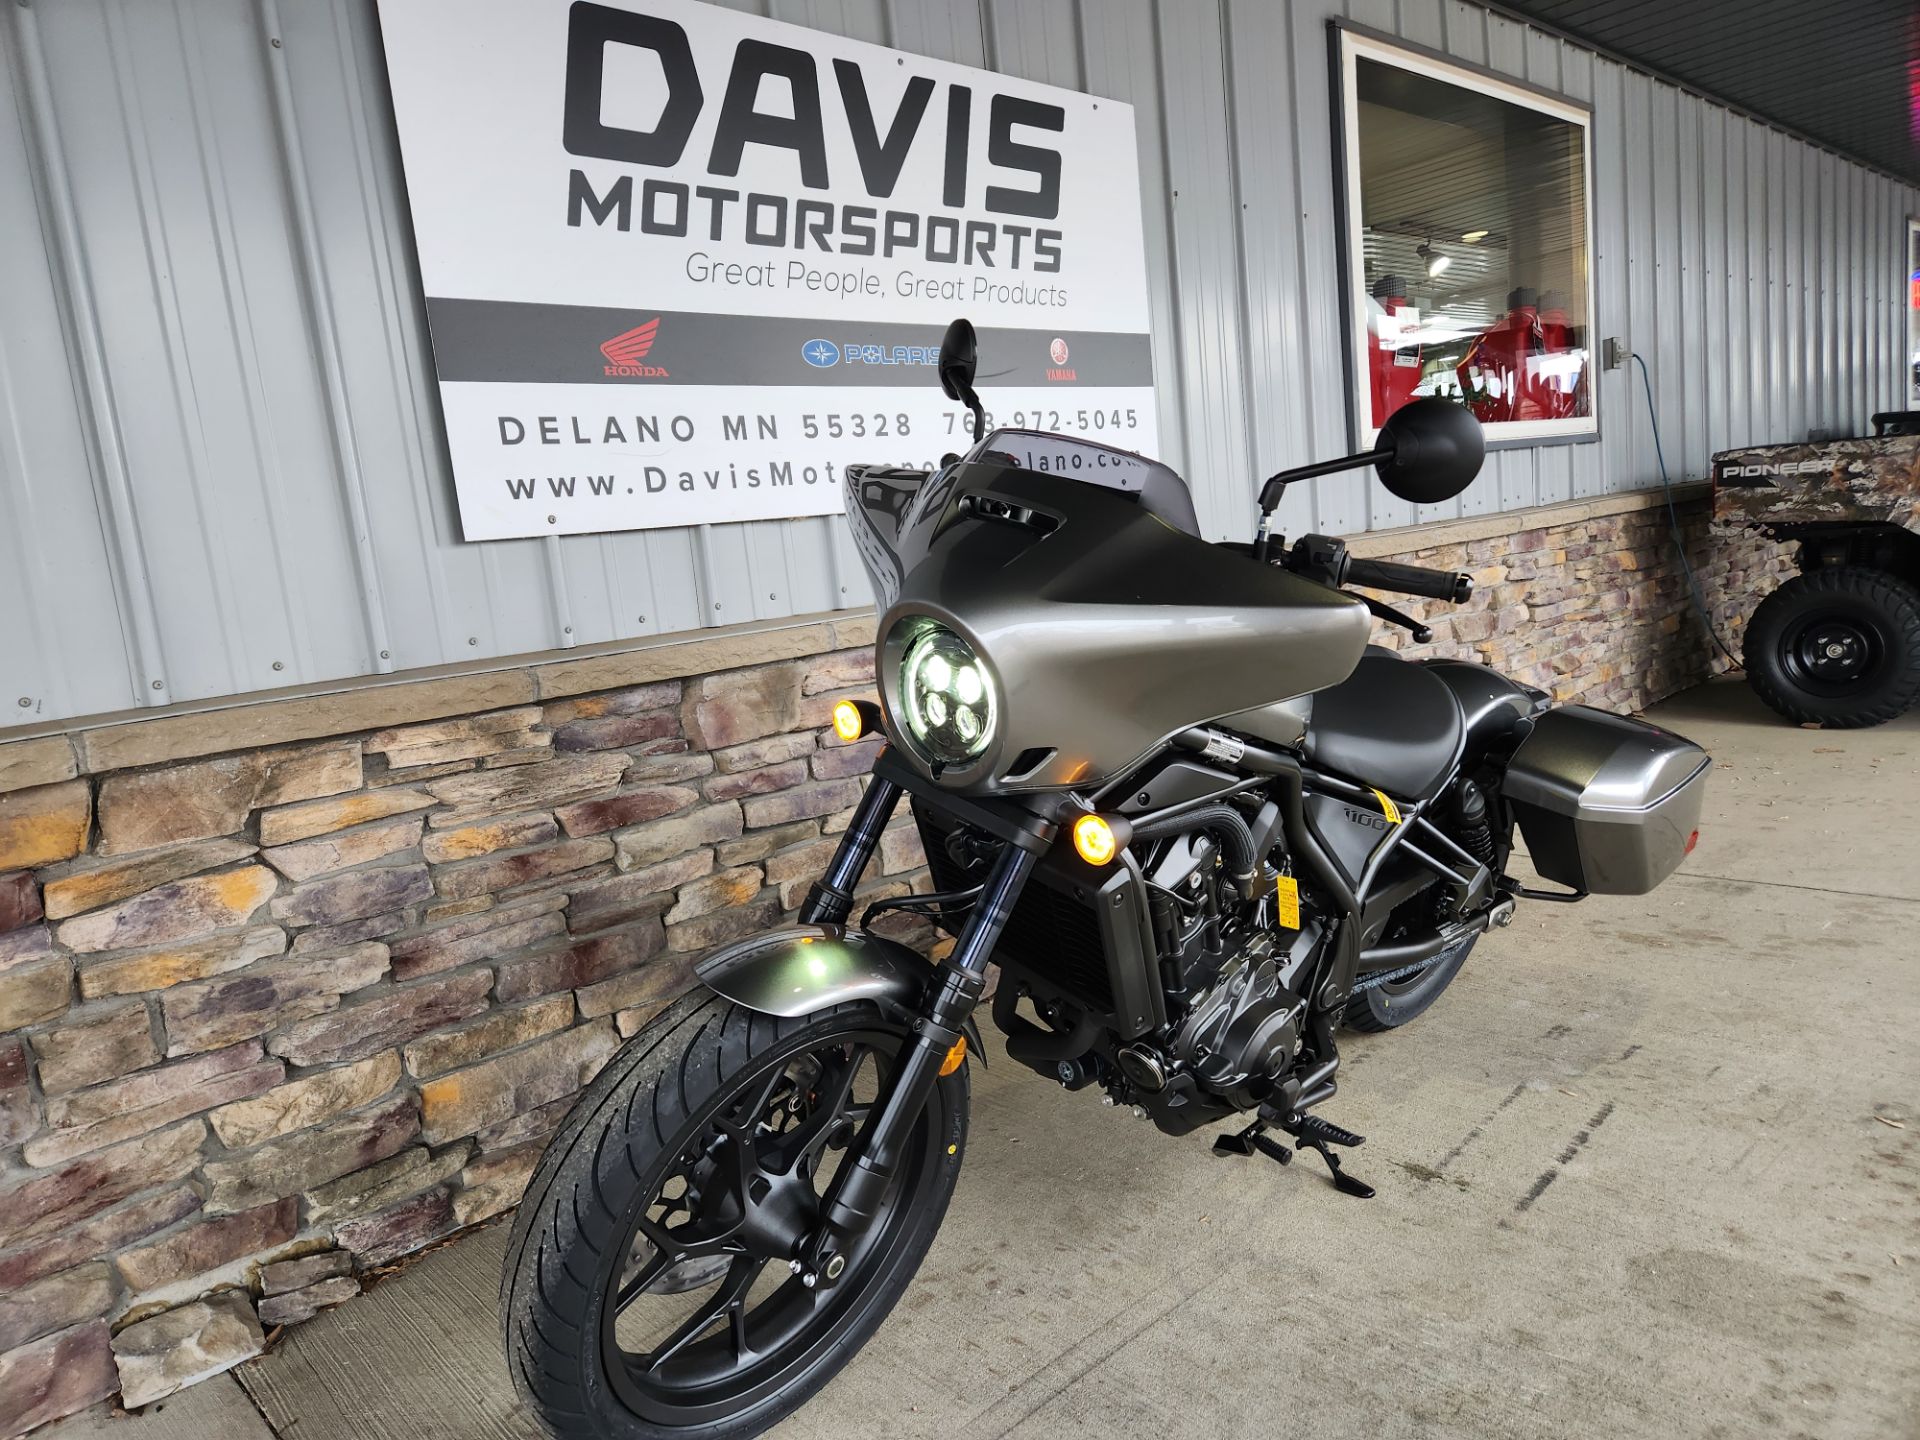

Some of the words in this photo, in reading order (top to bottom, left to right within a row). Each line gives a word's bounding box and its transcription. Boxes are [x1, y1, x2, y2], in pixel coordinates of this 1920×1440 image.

[562, 0, 1066, 220] DAVIS
[567, 168, 1063, 273] MOTORSPORTS
[685, 251, 777, 288] Great
[786, 260, 886, 301] People,
[895, 269, 965, 302] Great
[972, 275, 1068, 308] Products
[843, 339, 941, 366] POLARIS
[603, 365, 670, 377] HONDA
[1046, 368, 1077, 381] YAMAHA
[497, 415, 695, 446] DELANO
[721, 414, 779, 441] MN
[801, 413, 911, 440] 55328
[942, 409, 1137, 434] 763-972-5045
[1722, 459, 1835, 479] PIONEER
[1343, 807, 1387, 831] 1100
